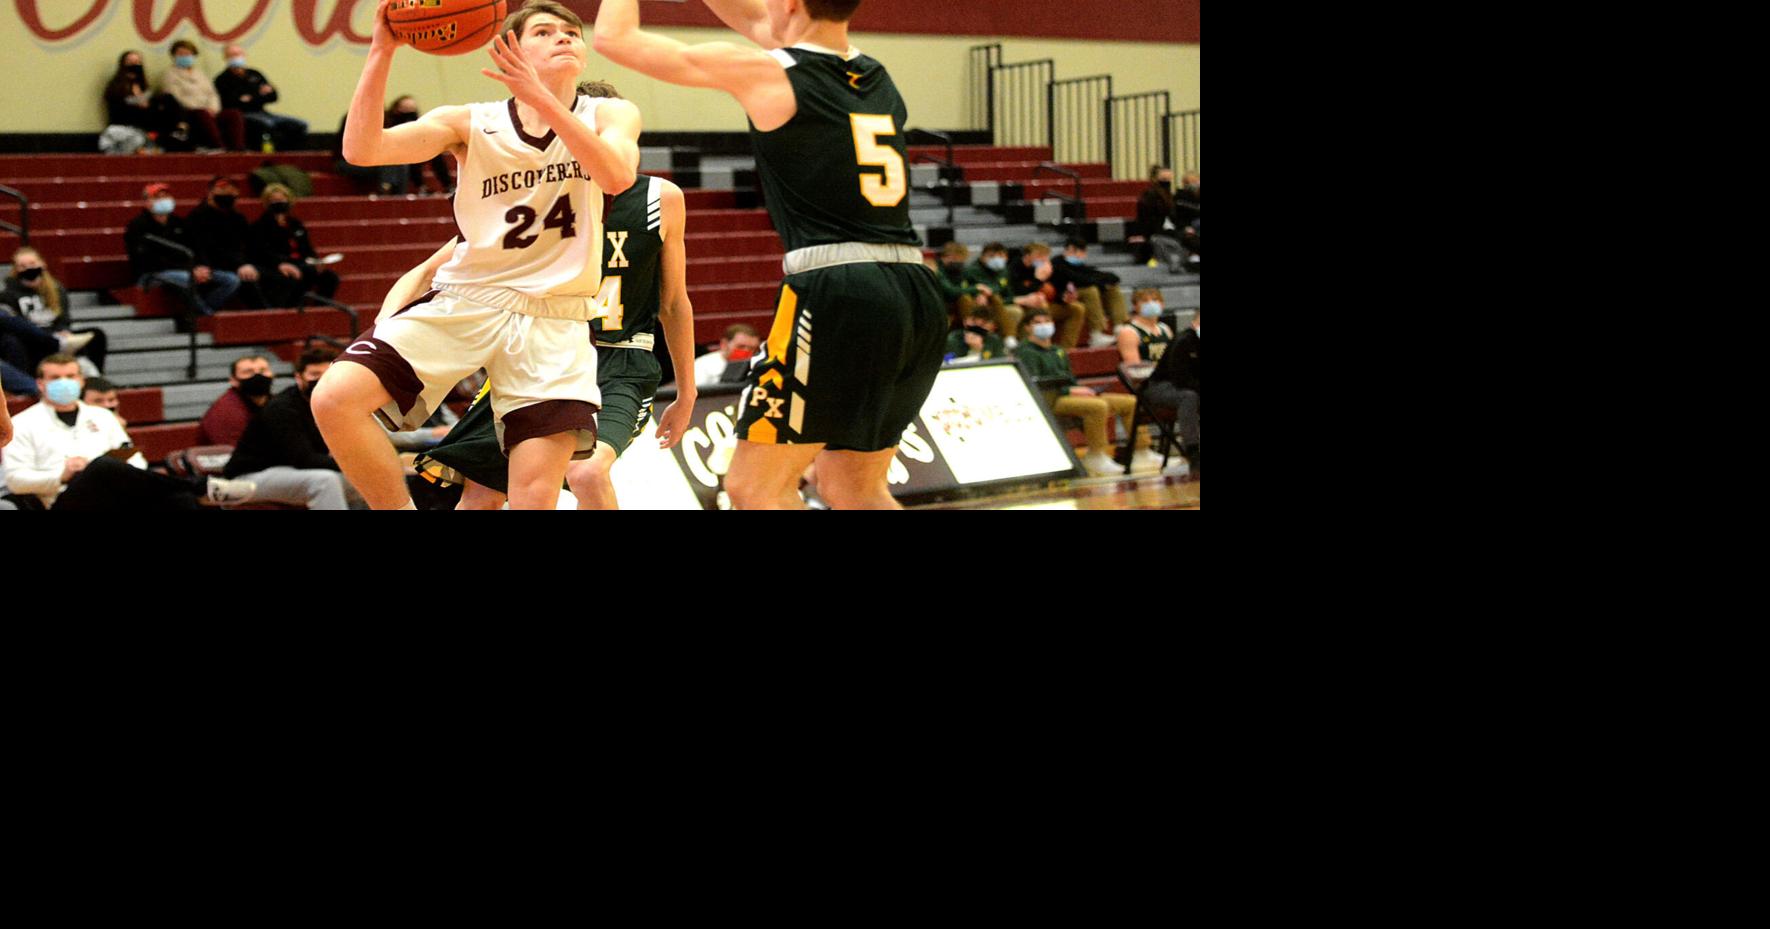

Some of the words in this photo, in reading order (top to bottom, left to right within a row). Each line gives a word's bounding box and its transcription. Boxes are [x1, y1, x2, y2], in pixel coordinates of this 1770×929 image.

[481, 160, 592, 200] DISCOVERR
[850, 113, 907, 207] 5
[503, 192, 577, 250] 24
[345, 340, 377, 355] C
